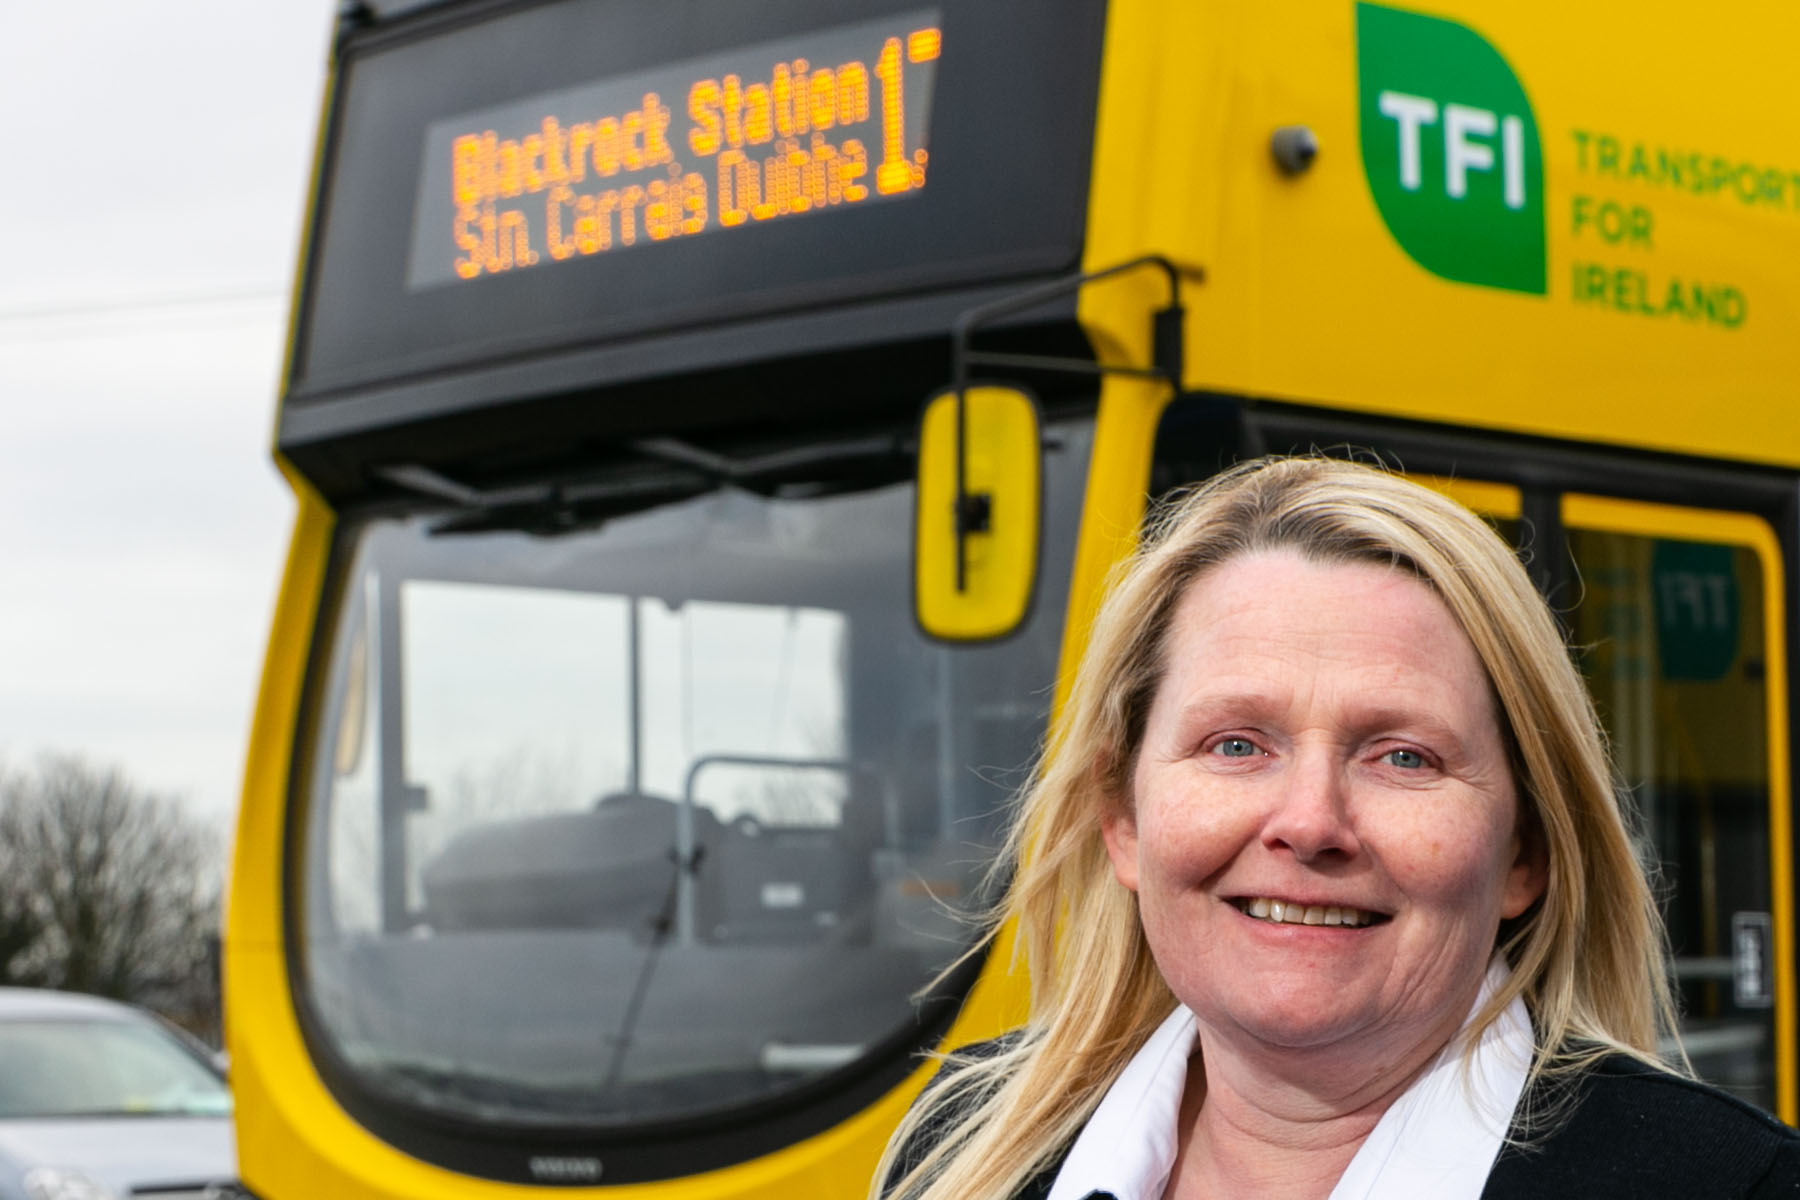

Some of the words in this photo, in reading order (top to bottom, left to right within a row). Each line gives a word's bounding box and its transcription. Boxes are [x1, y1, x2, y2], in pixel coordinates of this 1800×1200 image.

[452, 92, 674, 204] Blackrock
[688, 58, 870, 157] Station
[1378, 89, 1527, 210] TFI
[1570, 195, 1655, 252] FOR
[1571, 263, 1748, 330] IRELAND
